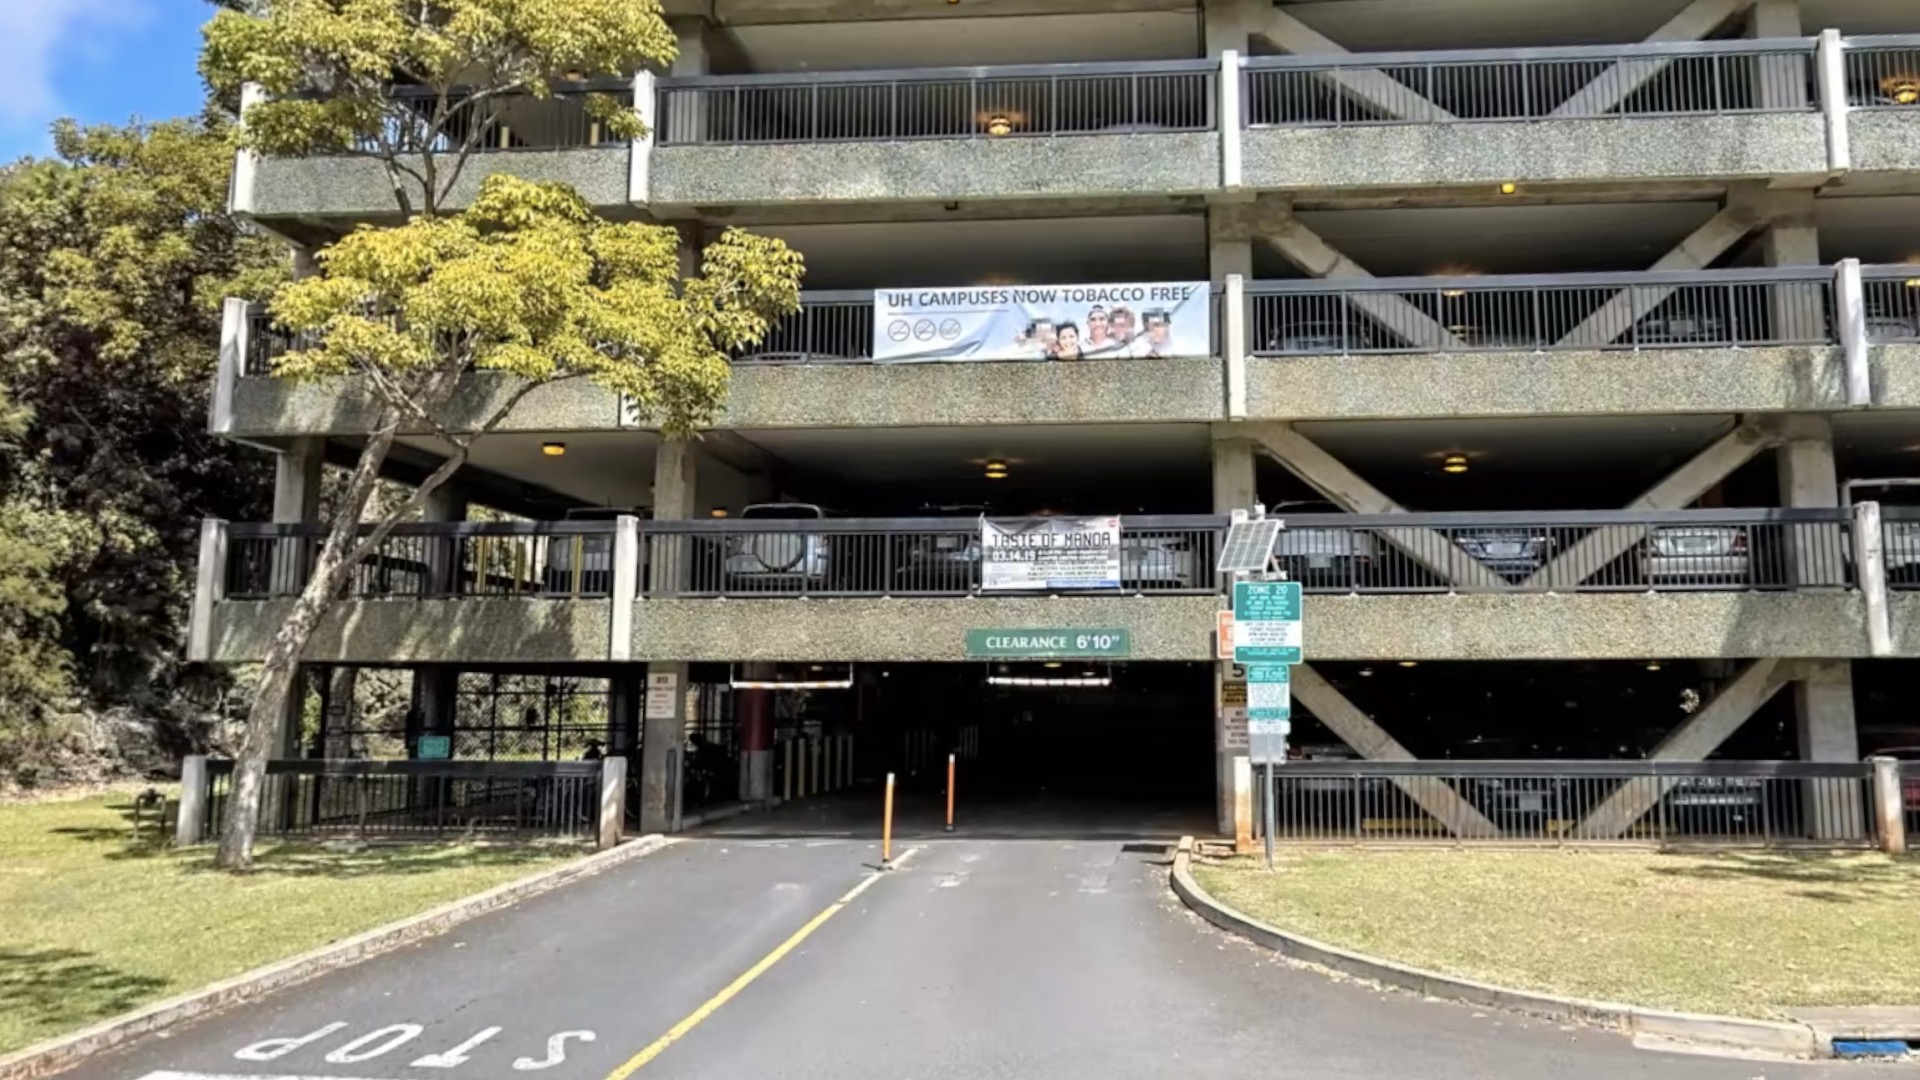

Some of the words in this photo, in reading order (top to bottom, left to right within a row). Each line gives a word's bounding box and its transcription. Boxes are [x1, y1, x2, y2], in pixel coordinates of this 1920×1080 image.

[888, 292, 913, 307] UH
[918, 290, 1008, 307] CAMPUSES
[1012, 289, 1058, 304] NOW
[1062, 287, 1144, 302] TOBACCO
[1150, 286, 1190, 301] FREE
[992, 533, 1038, 548] TASTE
[1041, 533, 1059, 547] OF
[1065, 531, 1111, 547] MANOA
[992, 550, 1036, 561] 03.14.19
[1275, 585, 1288, 595] 20
[986, 636, 1067, 649] CLEARANCE
[1076, 635, 1120, 649] 6'10"
[233, 1021, 596, 1071] STOP
